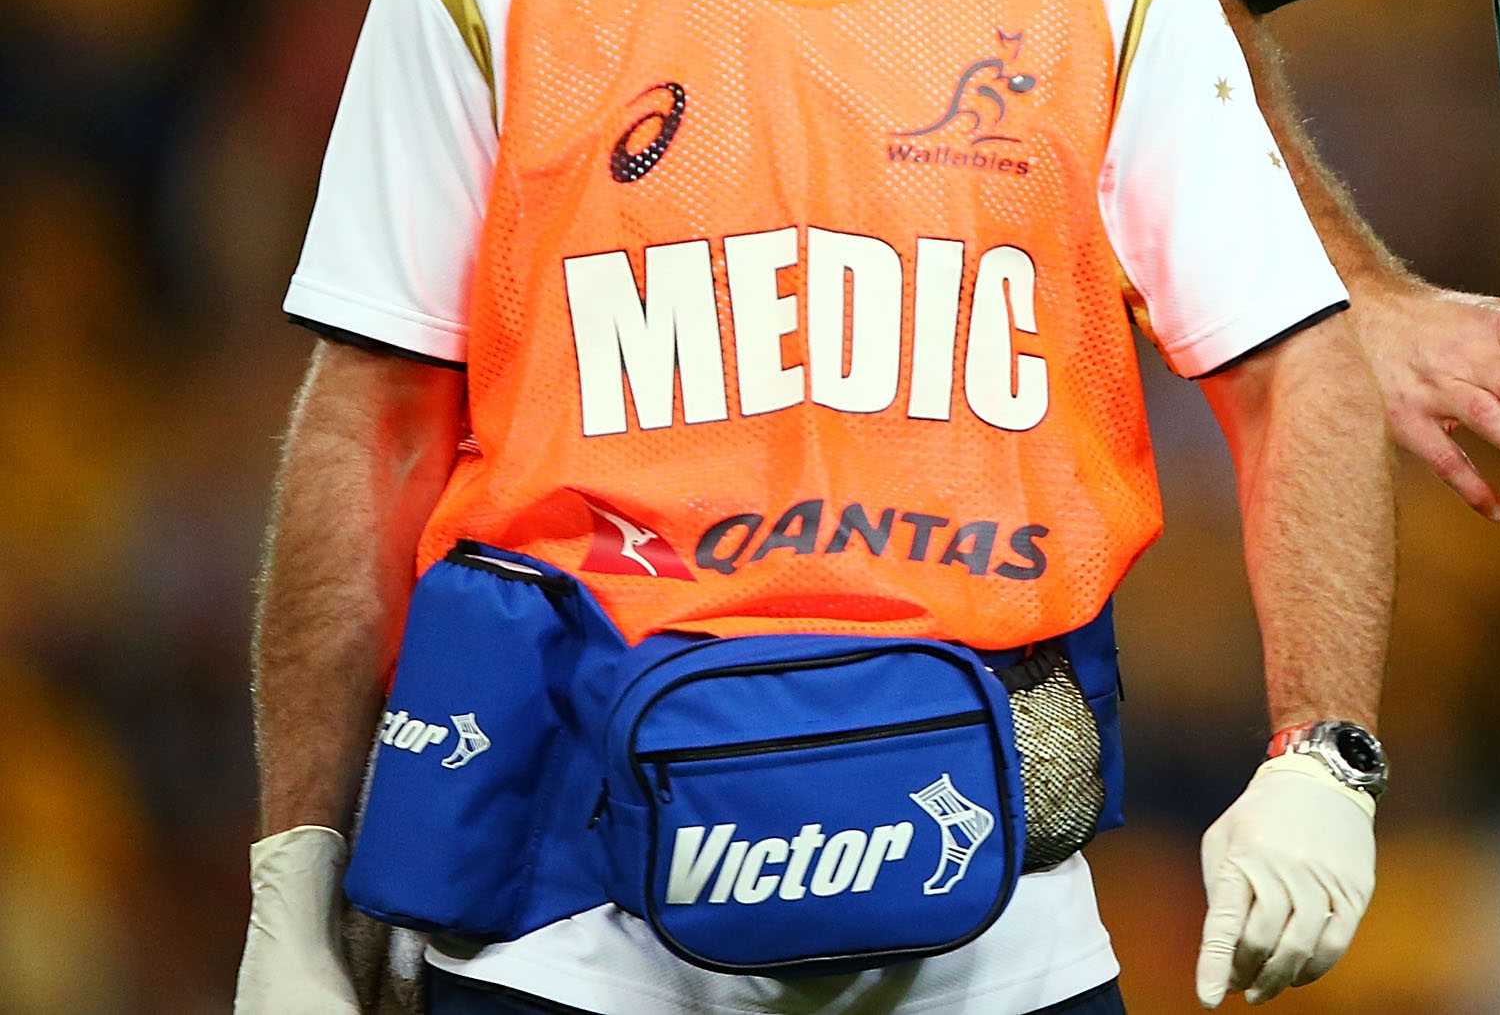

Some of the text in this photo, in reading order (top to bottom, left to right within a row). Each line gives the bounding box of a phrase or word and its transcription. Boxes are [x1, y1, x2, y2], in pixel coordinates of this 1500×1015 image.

[888, 145, 1029, 174] Wallabies
[564, 225, 1049, 437] MEDIC
[695, 499, 1049, 580] QANTAS
[665, 821, 913, 905] Victor
